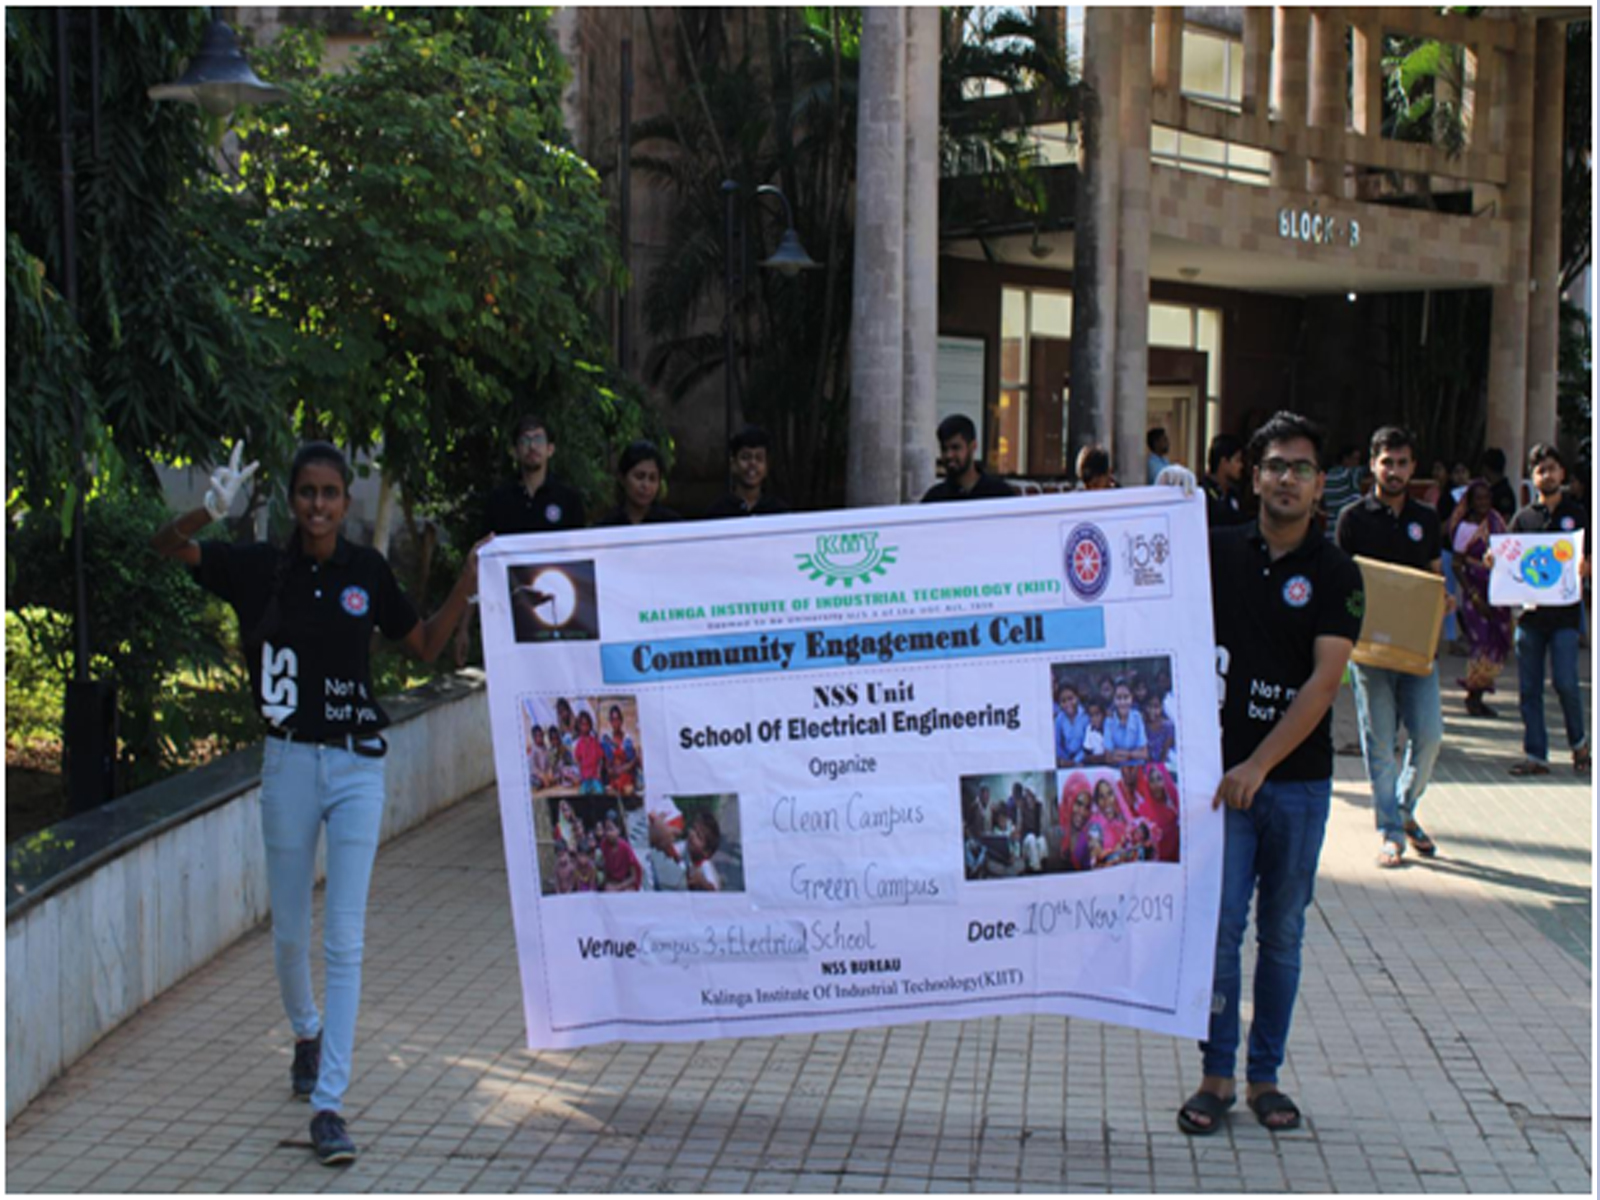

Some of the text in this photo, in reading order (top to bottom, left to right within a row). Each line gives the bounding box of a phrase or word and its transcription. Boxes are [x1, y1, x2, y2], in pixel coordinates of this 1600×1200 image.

[1278, 208, 1334, 244] BLOCK
[639, 579, 1060, 623] KALINGA INSTITUTE OF INDUSTRIAL TECHNOLOGY (KIIT)
[632, 614, 1045, 673] Community Engagement Cell
[325, 677, 355, 696] Not
[813, 681, 915, 708] NSS Unit
[1251, 679, 1282, 699] Not
[325, 701, 352, 721] but
[1248, 701, 1276, 721] but
[679, 704, 1021, 750] School Of Electrical Engineering
[809, 755, 877, 780] Organize
[772, 791, 924, 836] Clean Campus
[790, 862, 939, 905] Green Campus
[811, 920, 876, 951] School
[821, 957, 901, 975] NSS BUREAU
[701, 989, 753, 1007] Kalinga
[756, 986, 809, 1002] Institute
[813, 985, 832, 1000] Of
[835, 981, 898, 999] Industrial
